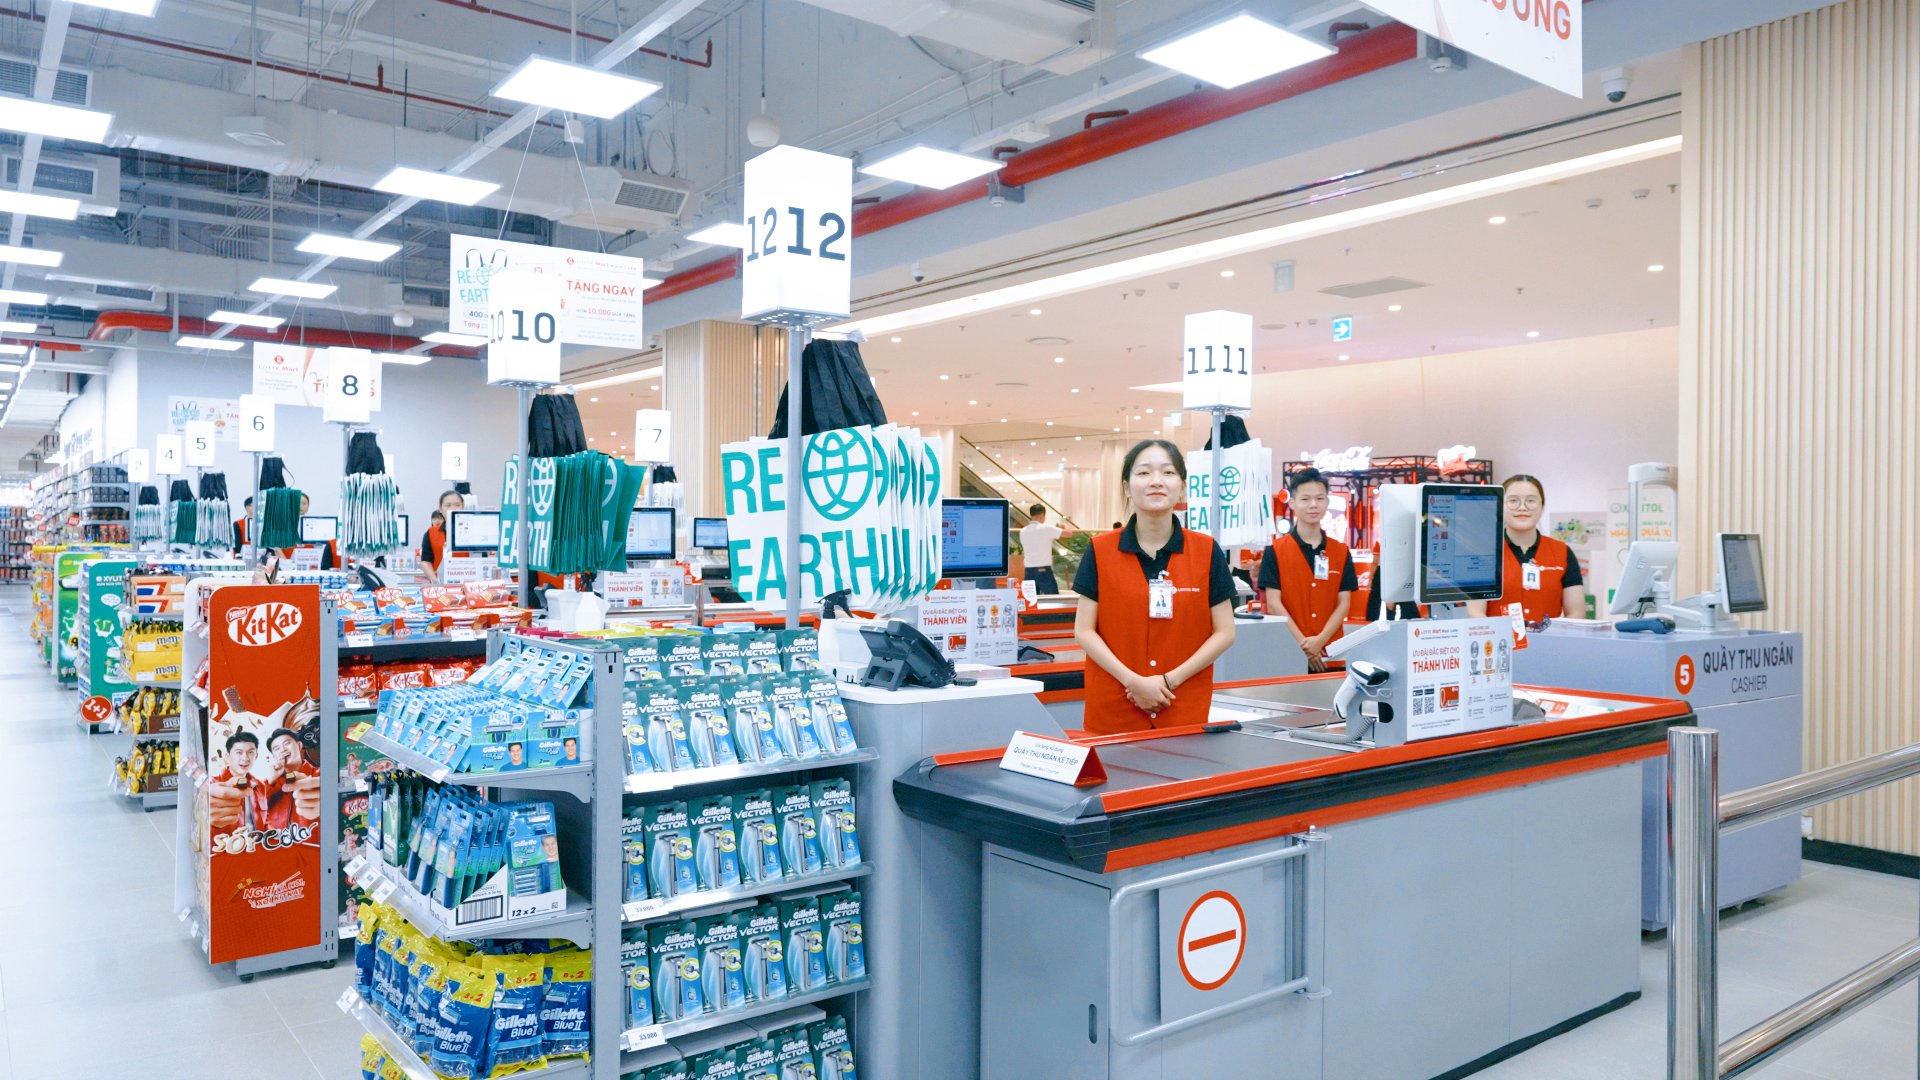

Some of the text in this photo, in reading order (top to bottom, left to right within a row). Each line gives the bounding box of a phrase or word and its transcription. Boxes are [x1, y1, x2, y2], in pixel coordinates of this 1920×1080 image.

[747, 207, 777, 262] 12
[788, 207, 846, 262] 12
[460, 288, 489, 304] EART
[603, 283, 635, 297] NGAY
[490, 310, 504, 344] 10
[511, 309, 556, 343] 10
[1187, 345, 1217, 375] 11
[1223, 345, 1248, 375] 11
[342, 375, 358, 396] 8
[253, 415, 265, 431] 6
[652, 428, 662, 443] 7
[196, 437, 207, 450] 5
[164, 449, 173, 460] 4
[454, 456, 461, 467] 3
[1621, 503, 1664, 513] XITOL
[1189, 505, 1240, 530] EATH
[728, 527, 880, 603] EARTH
[236, 604, 300, 645] KitKat
[923, 613, 967, 626] THÀNH VIÊN
[713, 642, 739, 651] Gillette
[750, 641, 776, 650] Gillette
[784, 644, 818, 653] VECTOR
[793, 638, 817, 647] Gillette
[628, 647, 657, 657] Gillette
[672, 645, 700, 655] Gillette
[702, 650, 740, 659] VECTOR
[740, 648, 777, 657] VECTOR
[623, 655, 658, 663] ECTOR
[661, 653, 701, 662] VECTOR
[1703, 642, 1793, 674] QUẦY THU NGÂN
[1412, 655, 1460, 673] THÀNH VIÊN
[1680, 664, 1690, 686] 5
[774, 686, 801, 695] Gillette
[811, 683, 836, 692] Gillette
[1731, 675, 1768, 694] CASHIER
[691, 693, 720, 703] Gillette
[735, 690, 762, 699] Gillette
[765, 692, 803, 702] VECTOR
[802, 689, 839, 699] VECTOR
[650, 697, 679, 707] Gillette
[681, 701, 721, 710] VECTOR
[726, 696, 764, 706] VECTOR
[85, 699, 108, 719] 1+1
[639, 702, 680, 714] VECTOR
[482, 745, 507, 754] Gillette
[1030, 749, 1041, 758] THU
[785, 795, 810, 805] Gillette
[823, 790, 850, 800] Gillette
[745, 800, 772, 811] Gillette
[776, 802, 810, 814] VECTOR
[813, 797, 851, 808] VECTOR
[657, 812, 688, 823] Gillette
[702, 806, 732, 817] Gillette
[735, 808, 773, 819] VECTOR
[622, 816, 642, 827] llette
[646, 820, 688, 832] VECTOR
[691, 814, 732, 826] VECTOR
[513, 839, 538, 848] Gillette
[511, 908, 523, 918] 12
[530, 906, 537, 914] 2
[833, 902, 860, 912] Gillette
[793, 908, 818, 920] Gillette
[822, 908, 860, 920] VECTOR
[750, 916, 778, 928] Gillette
[783, 915, 819, 929] VECTOR
[709, 924, 738, 936] Gillette
[739, 924, 779, 937] VECTOR
[664, 932, 696, 945] Gillette
[697, 932, 738, 945] VECTOR
[621, 940, 647, 951] illette
[652, 940, 696, 954] VECTOR
[621, 949, 647, 960] CTOR
[540, 1008, 586, 1021] Gillette
[495, 1014, 538, 1030] Gillett
[553, 1019, 574, 1030] Blue
[435, 1026, 473, 1044] Gillette
[511, 1027, 532, 1038] Blue
[823, 1028, 846, 1041] Gillette
[440, 1041, 461, 1052] Blue
[782, 1040, 808, 1053] Gillette
[813, 1035, 848, 1050] VECTOR
[747, 1051, 774, 1064] Gillette
[774, 1046, 810, 1062] VECTOR
[708, 1061, 735, 1074] Gillette
[737, 1057, 774, 1073] VECTOR
